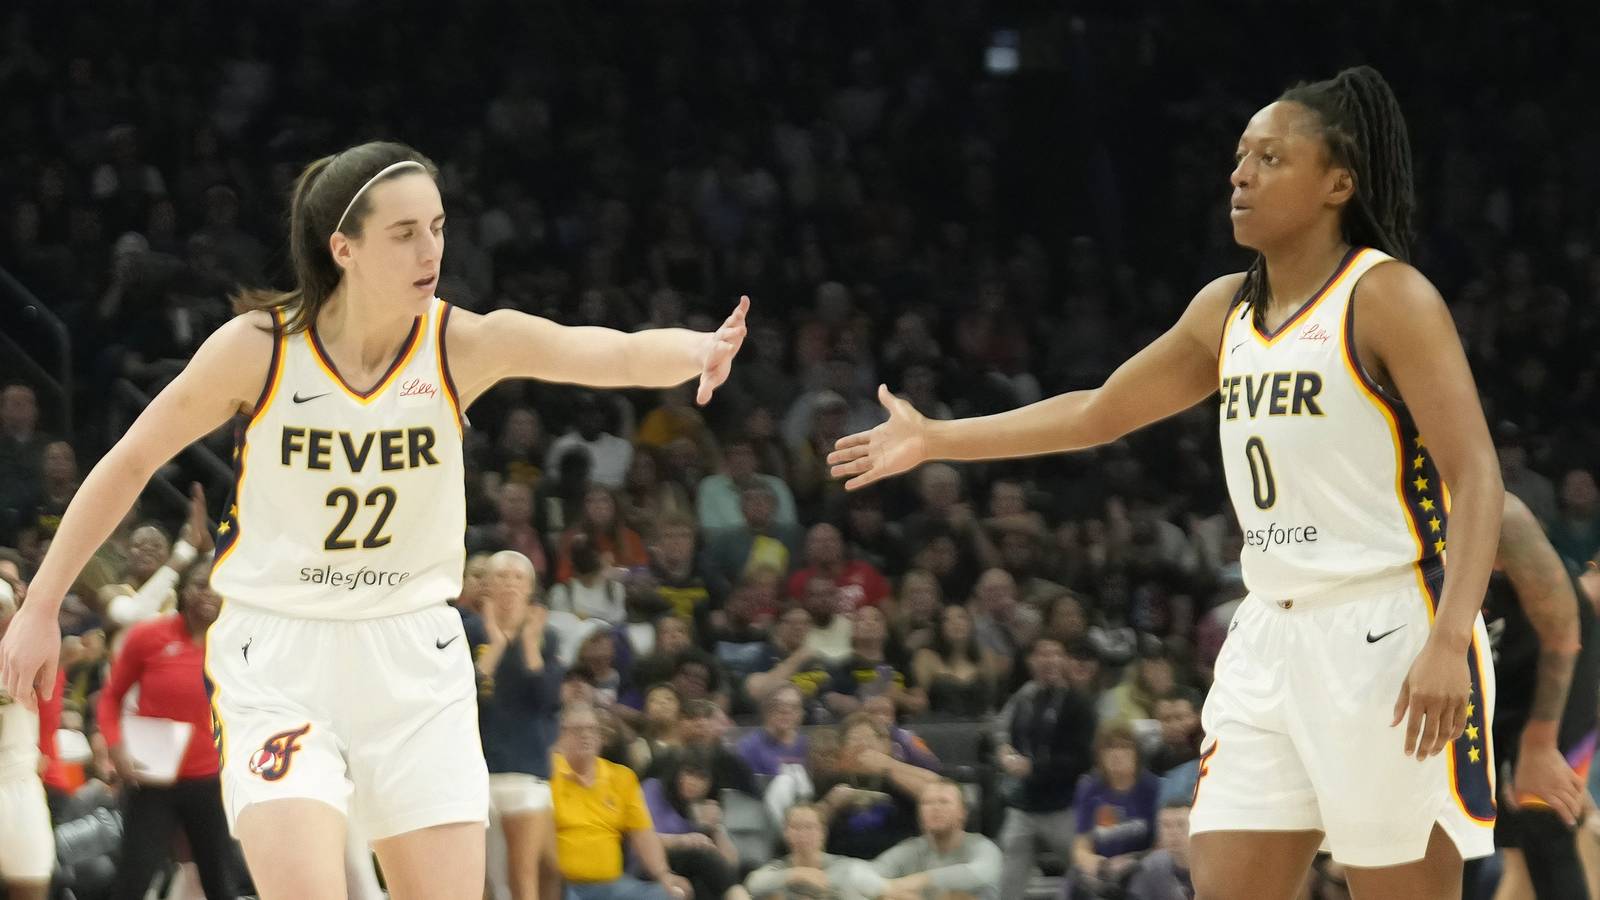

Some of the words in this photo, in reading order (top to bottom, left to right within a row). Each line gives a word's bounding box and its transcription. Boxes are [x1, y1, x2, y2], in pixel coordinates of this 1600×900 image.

[1300, 323, 1330, 345] Lilly
[400, 378, 437, 398] Lilly
[280, 424, 440, 474] FEVER
[1245, 435, 1277, 511] 0
[323, 486, 398, 551] 22
[1246, 522, 1318, 553] esforce
[300, 565, 410, 590] salesforce
